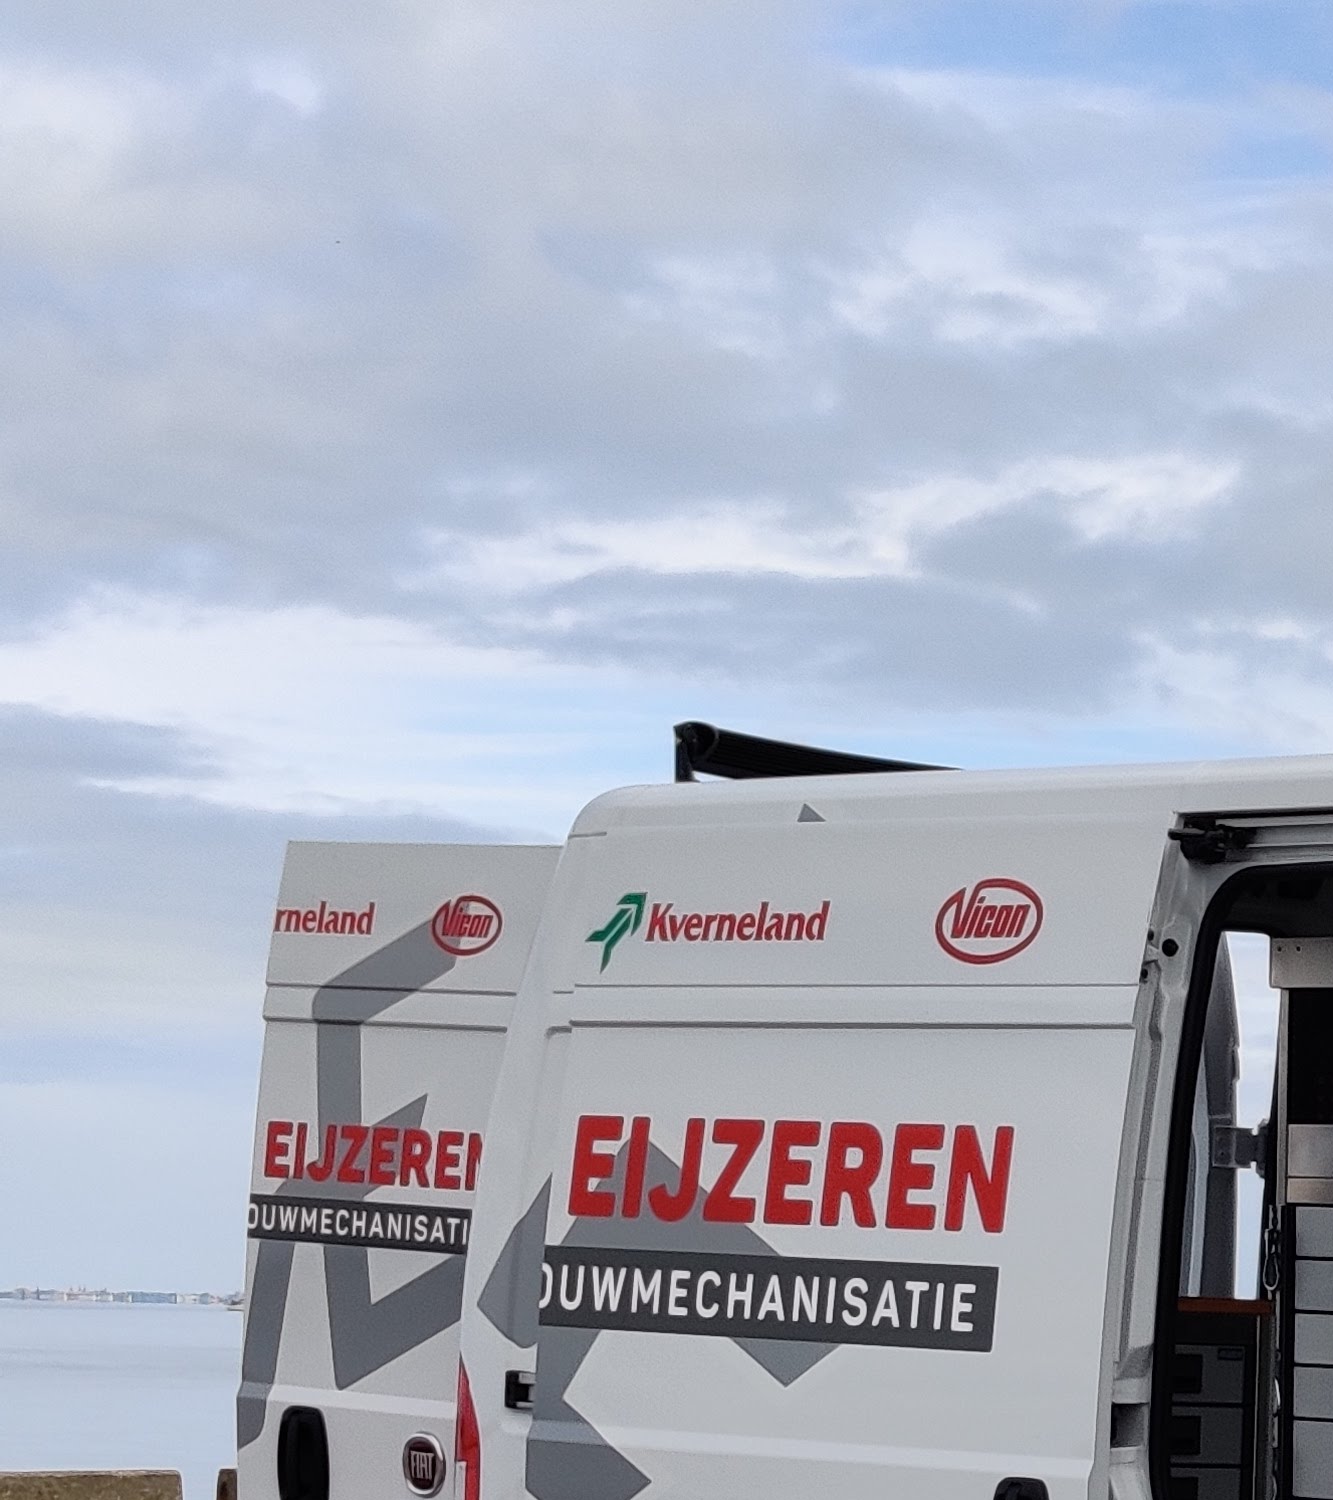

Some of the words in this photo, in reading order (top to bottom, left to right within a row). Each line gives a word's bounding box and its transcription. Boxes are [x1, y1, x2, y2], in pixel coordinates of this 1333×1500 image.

[274, 901, 375, 935] rneland
[437, 899, 497, 946] Vicon
[645, 900, 830, 942] Kverneland
[943, 884, 1034, 946] Vicon
[567, 1115, 1015, 1234] EIJZEREN
[248, 1203, 469, 1245] OUWMECHANISATI
[410, 1451, 434, 1480] FIAT
